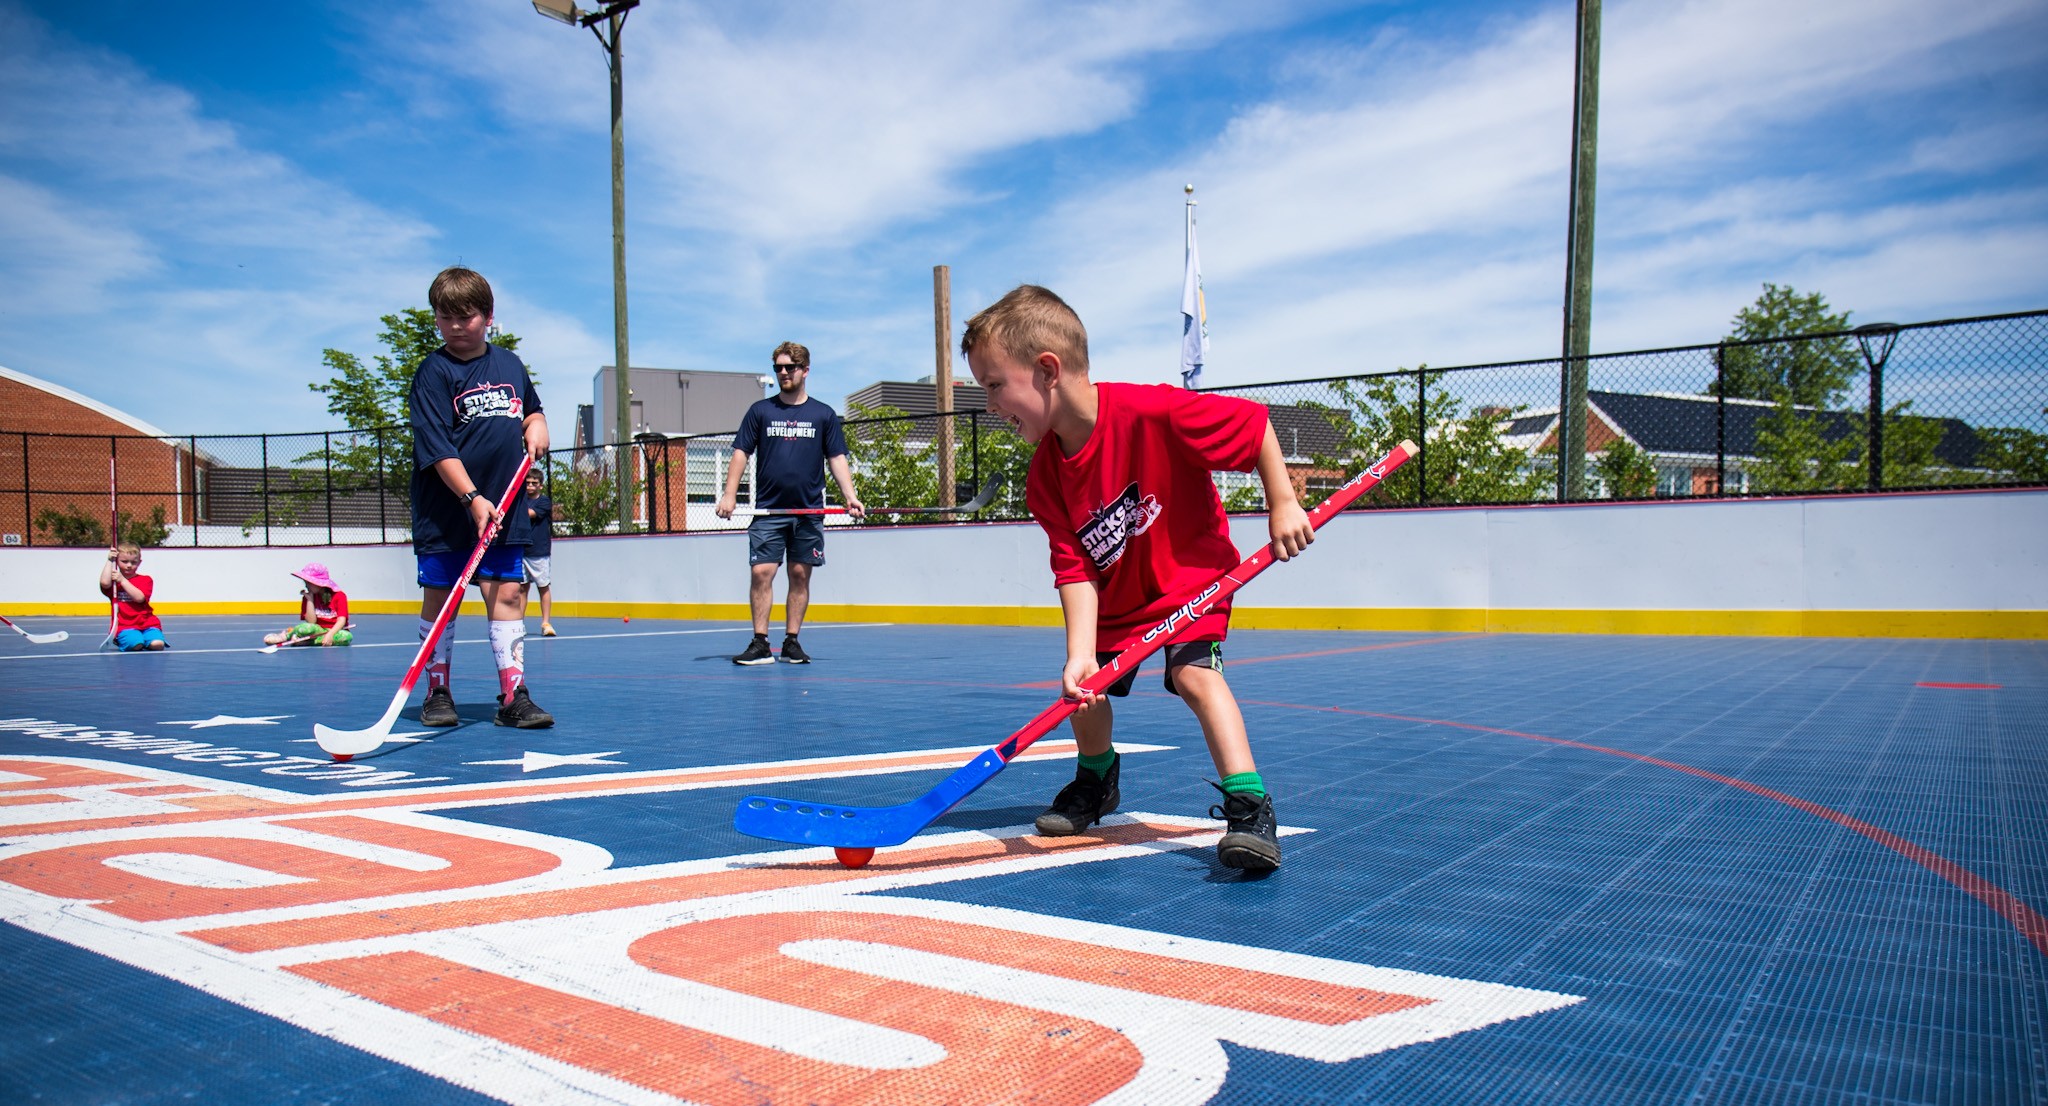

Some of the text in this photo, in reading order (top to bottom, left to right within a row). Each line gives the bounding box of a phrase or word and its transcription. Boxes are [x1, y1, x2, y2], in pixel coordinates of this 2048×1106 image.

[767, 427, 816, 438] DEVELOPMENT
[1081, 505, 1126, 551] STICKS
[460, 546, 486, 589] WASHINGTON
